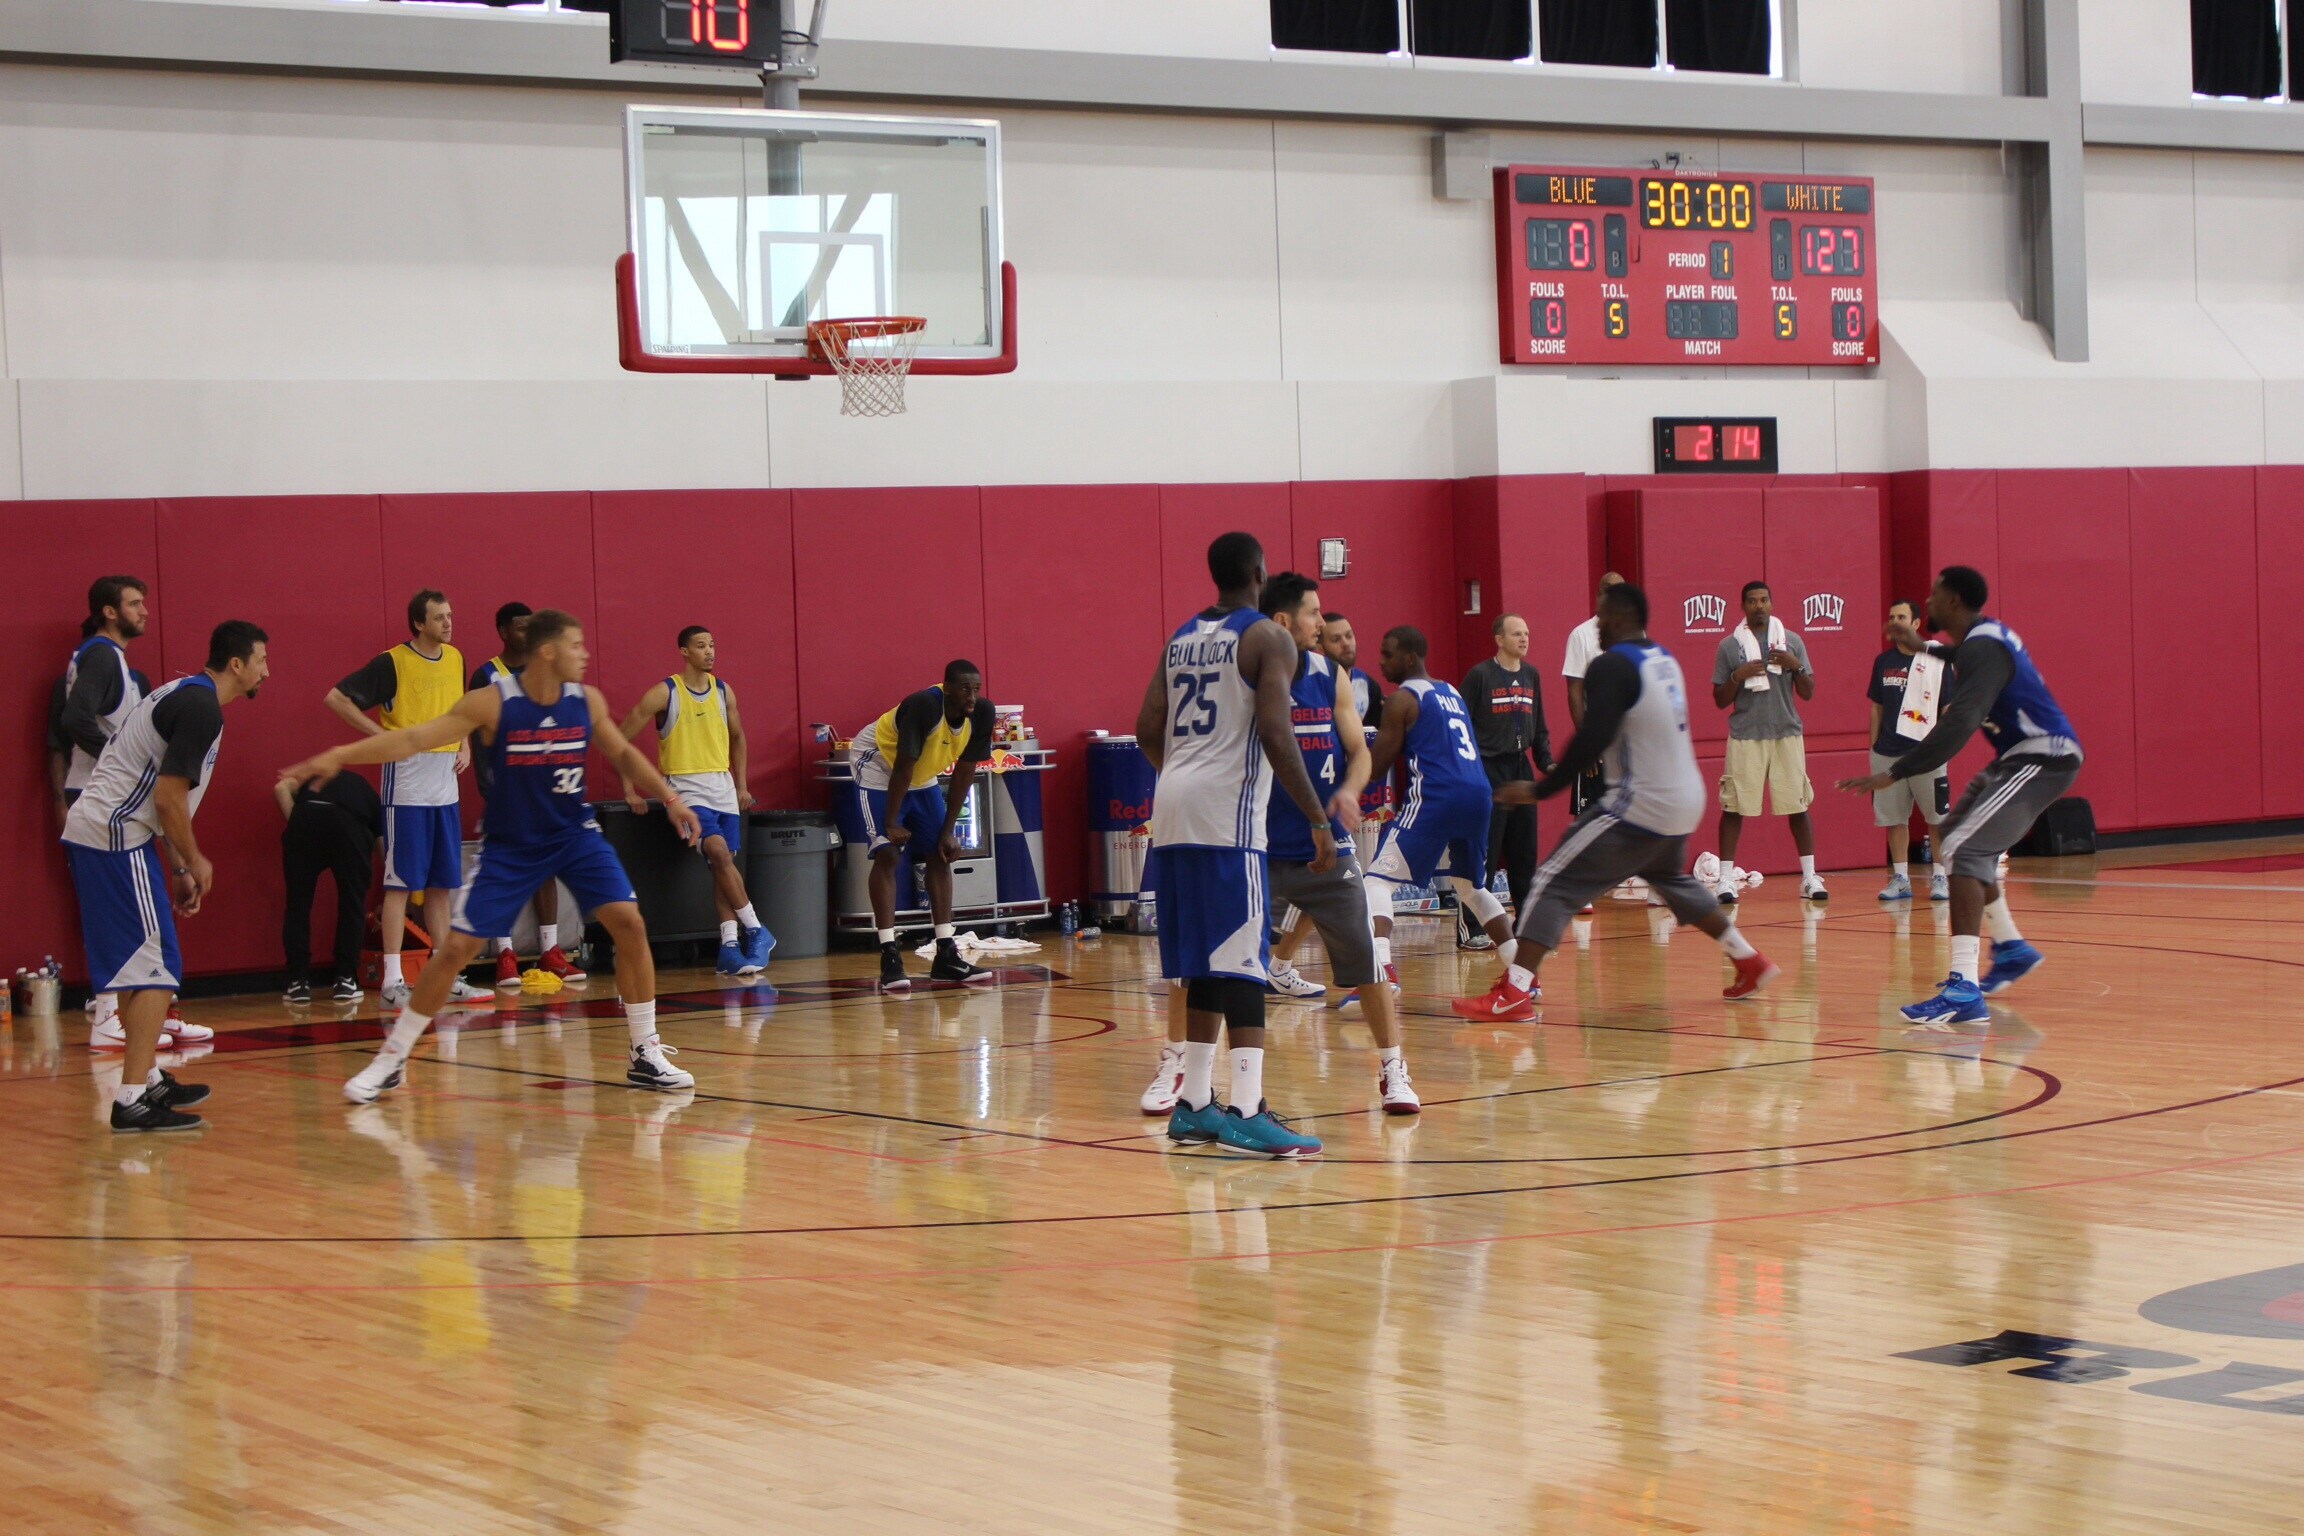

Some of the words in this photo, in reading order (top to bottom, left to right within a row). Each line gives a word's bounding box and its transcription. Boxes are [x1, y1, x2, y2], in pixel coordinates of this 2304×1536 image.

[1549, 176, 1597, 204] BLUE
[1786, 184, 1844, 212] WHITE
[1647, 181, 1750, 229] 30:00
[1668, 252, 1706, 268] PERIOD
[1806, 228, 1860, 273] 127
[1530, 282, 1565, 297] FOULS
[1601, 283, 1629, 298] T.O.L.
[1666, 284, 1705, 299] PLAYER
[1711, 285, 1738, 300] FOUL
[1771, 286, 1798, 300] T.O.L.
[1831, 287, 1863, 301] FOULS
[1531, 340, 1566, 354] SCORE
[1685, 341, 1721, 355] MATCH
[1832, 342, 1865, 356] SCORE
[1683, 594, 1727, 627] UNLV
[1803, 593, 1845, 626] UNLV
[1168, 640, 1237, 668] BULLOCK
[1173, 671, 1221, 737] 25
[1293, 707, 1333, 722] GELES
[1434, 692, 1465, 716] PAUL
[1448, 718, 1477, 761] 3
[1320, 753, 1336, 784] 4
[552, 766, 584, 794] 32
[1110, 798, 1150, 819] Red
[770, 829, 806, 839] BRUTE
[1113, 841, 1148, 850] ENERG
